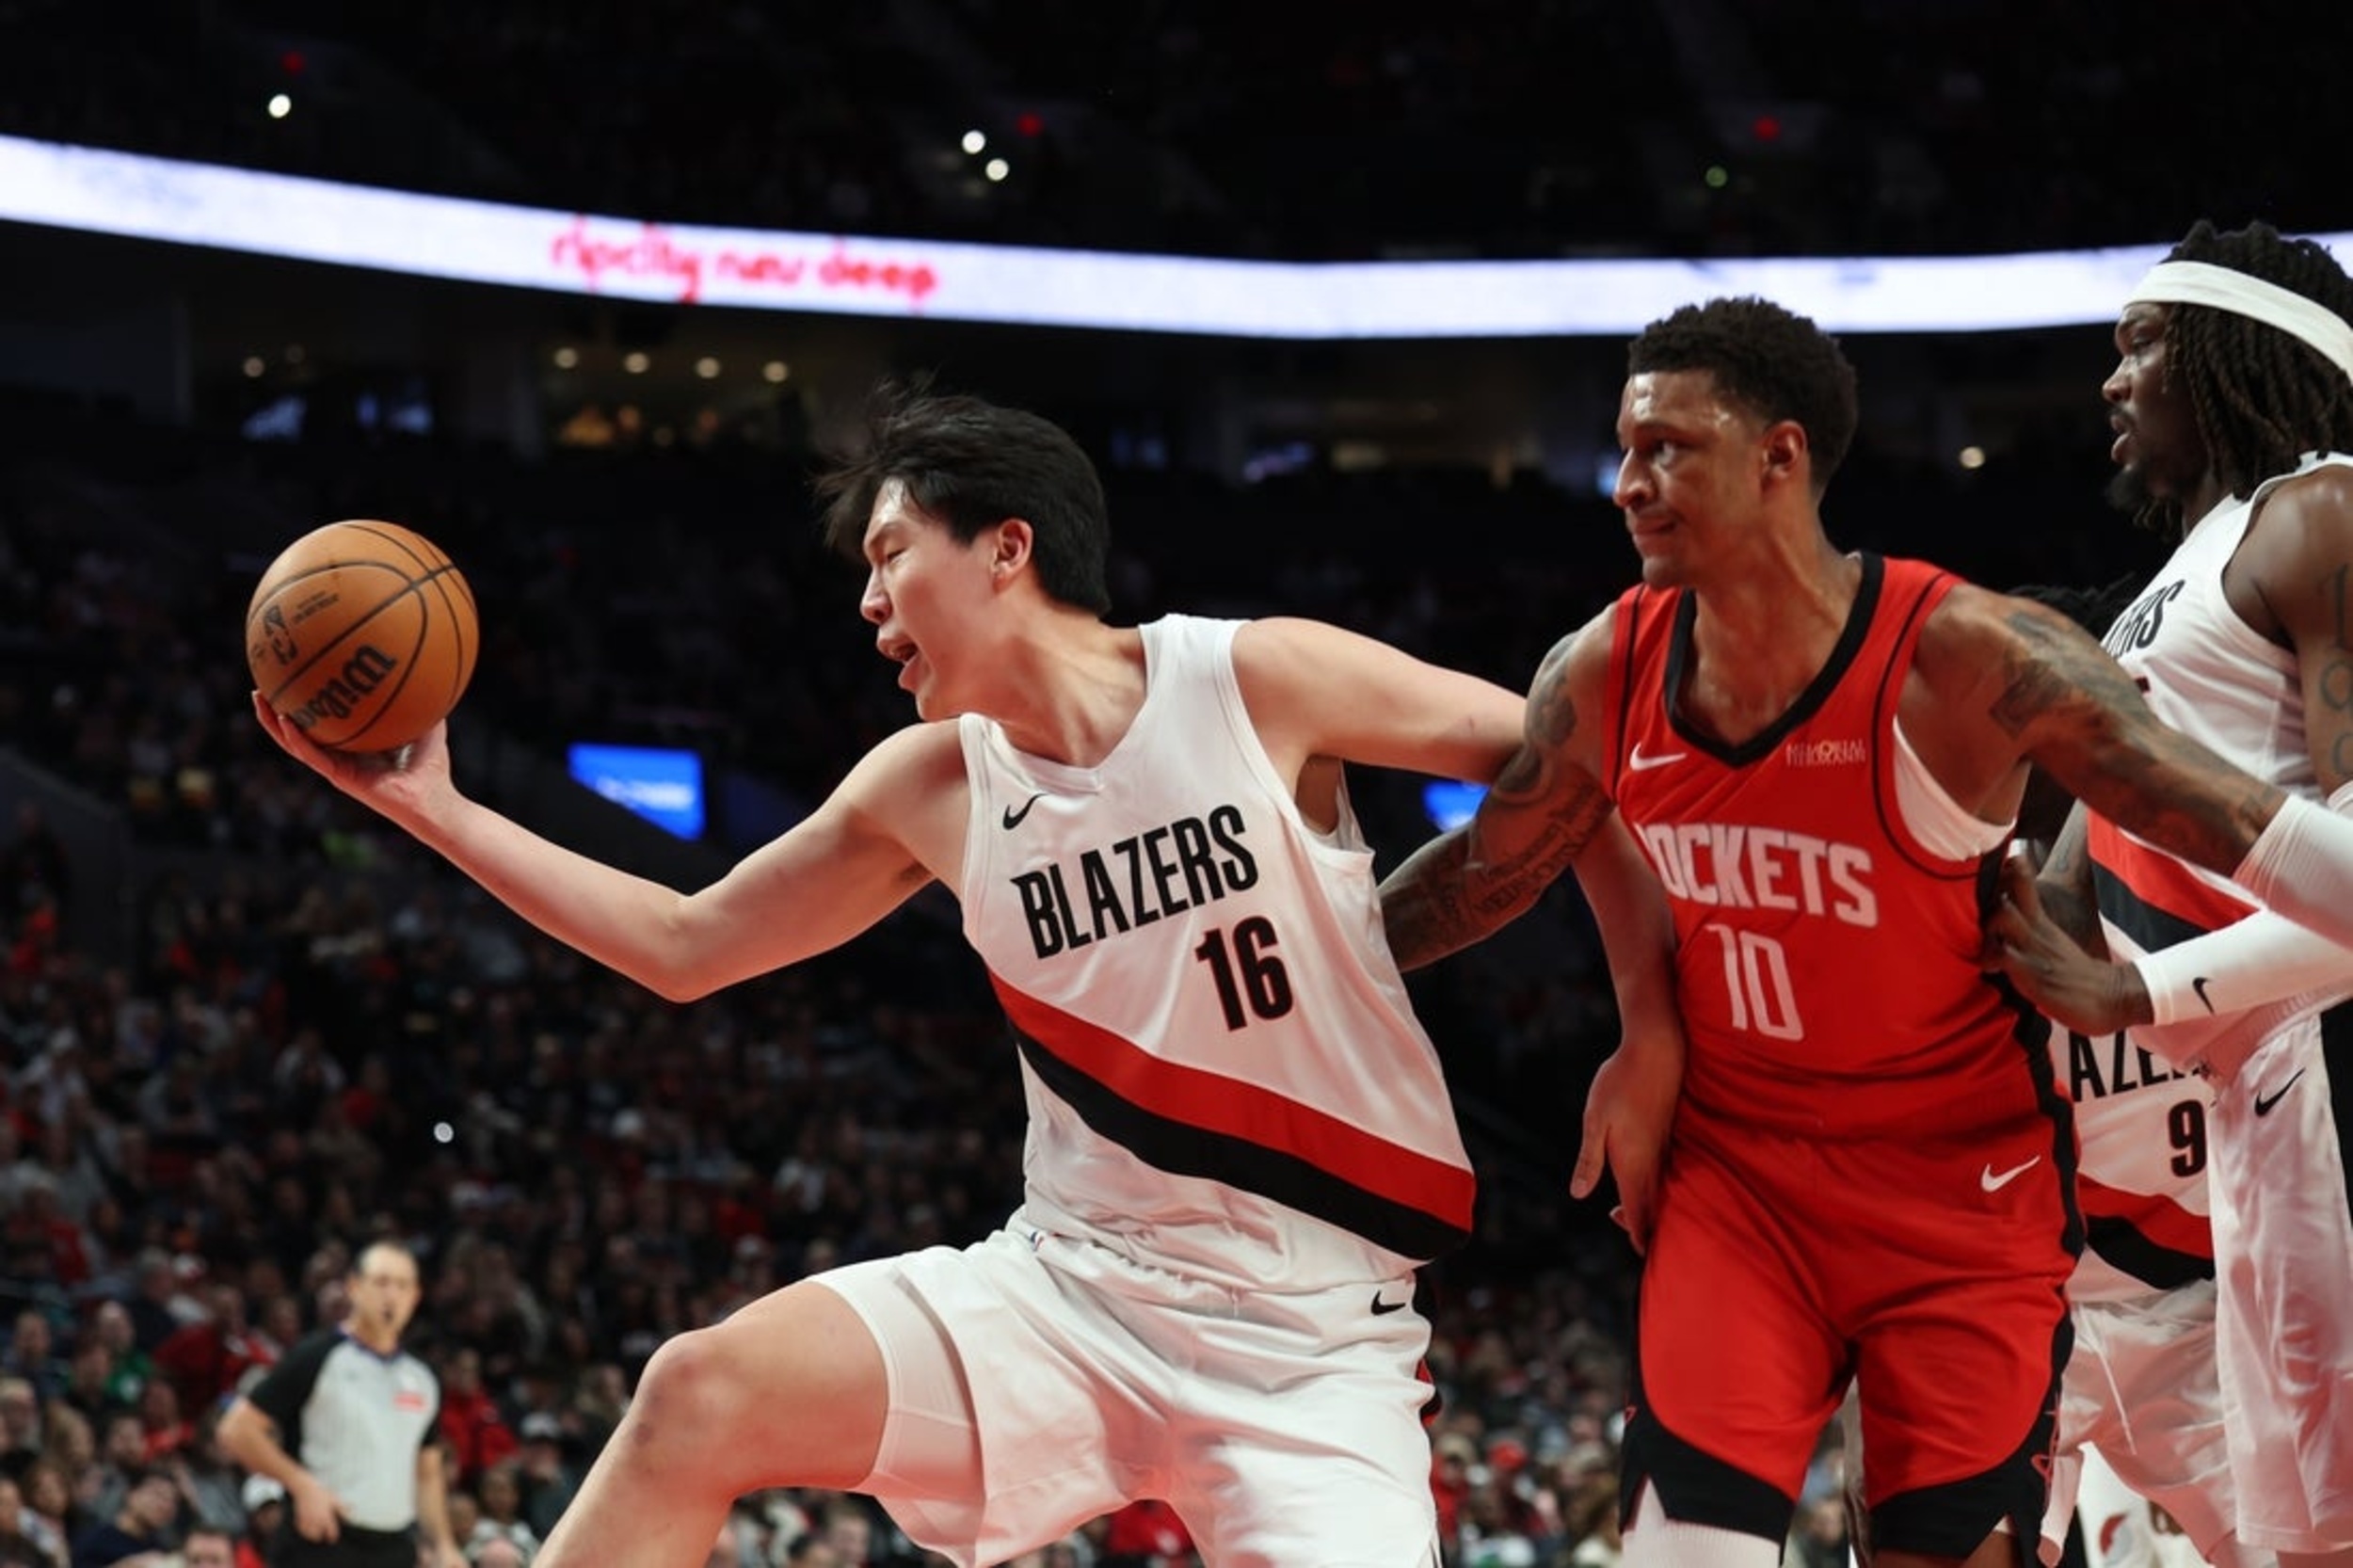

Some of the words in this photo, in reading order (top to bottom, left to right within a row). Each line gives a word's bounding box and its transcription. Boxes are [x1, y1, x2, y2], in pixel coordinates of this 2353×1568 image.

[1010, 804, 1259, 960] BLAZERS
[1632, 821, 1879, 929] OCKETS
[1194, 915, 1294, 1032] 16
[1704, 923, 1805, 1042] 10
[2168, 1098, 2208, 1178] 9
